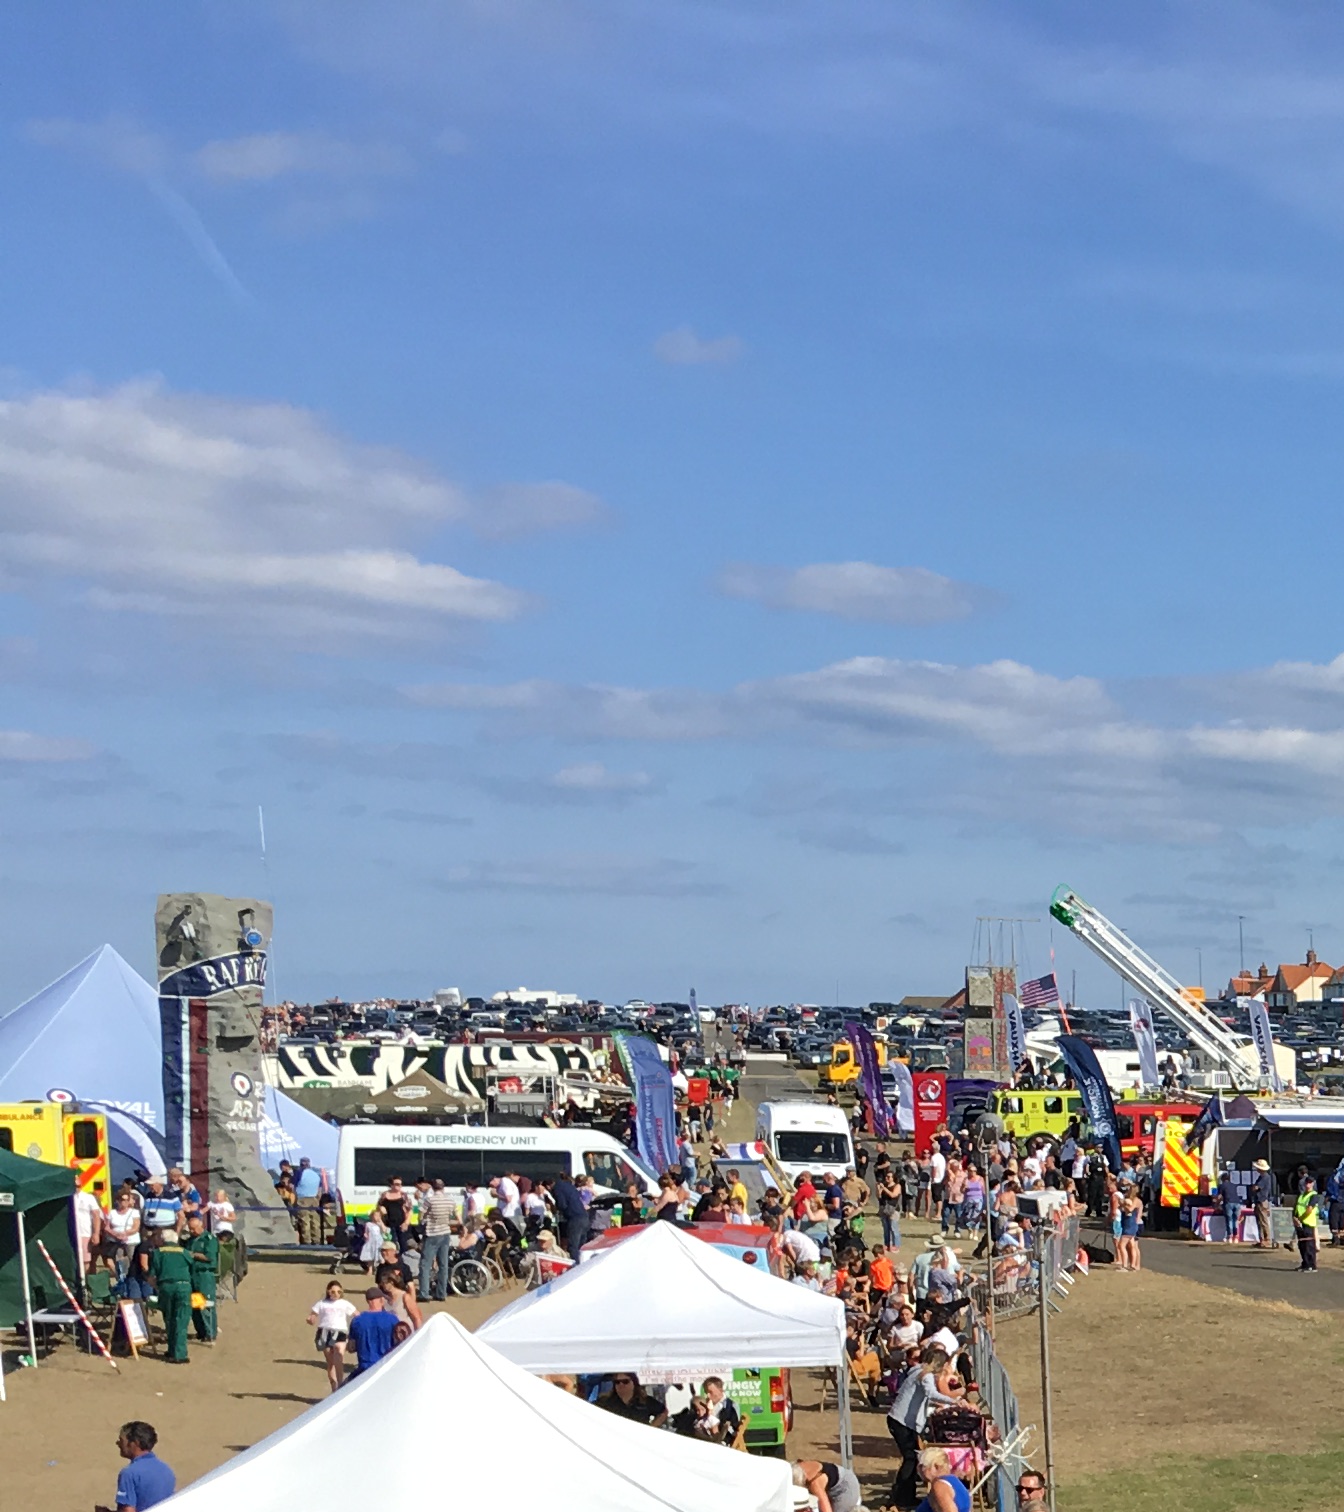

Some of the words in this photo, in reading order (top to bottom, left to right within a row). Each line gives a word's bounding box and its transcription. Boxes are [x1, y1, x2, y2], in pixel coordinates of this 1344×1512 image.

[201, 957, 240, 991] RAF
[1008, 1010, 1021, 1071] VAUXHA
[1254, 1015, 1269, 1075] VAUXHA
[392, 1134, 422, 1144] HIGH
[426, 1134, 506, 1145] DEPENDENCY
[510, 1136, 538, 1145] UNIT
